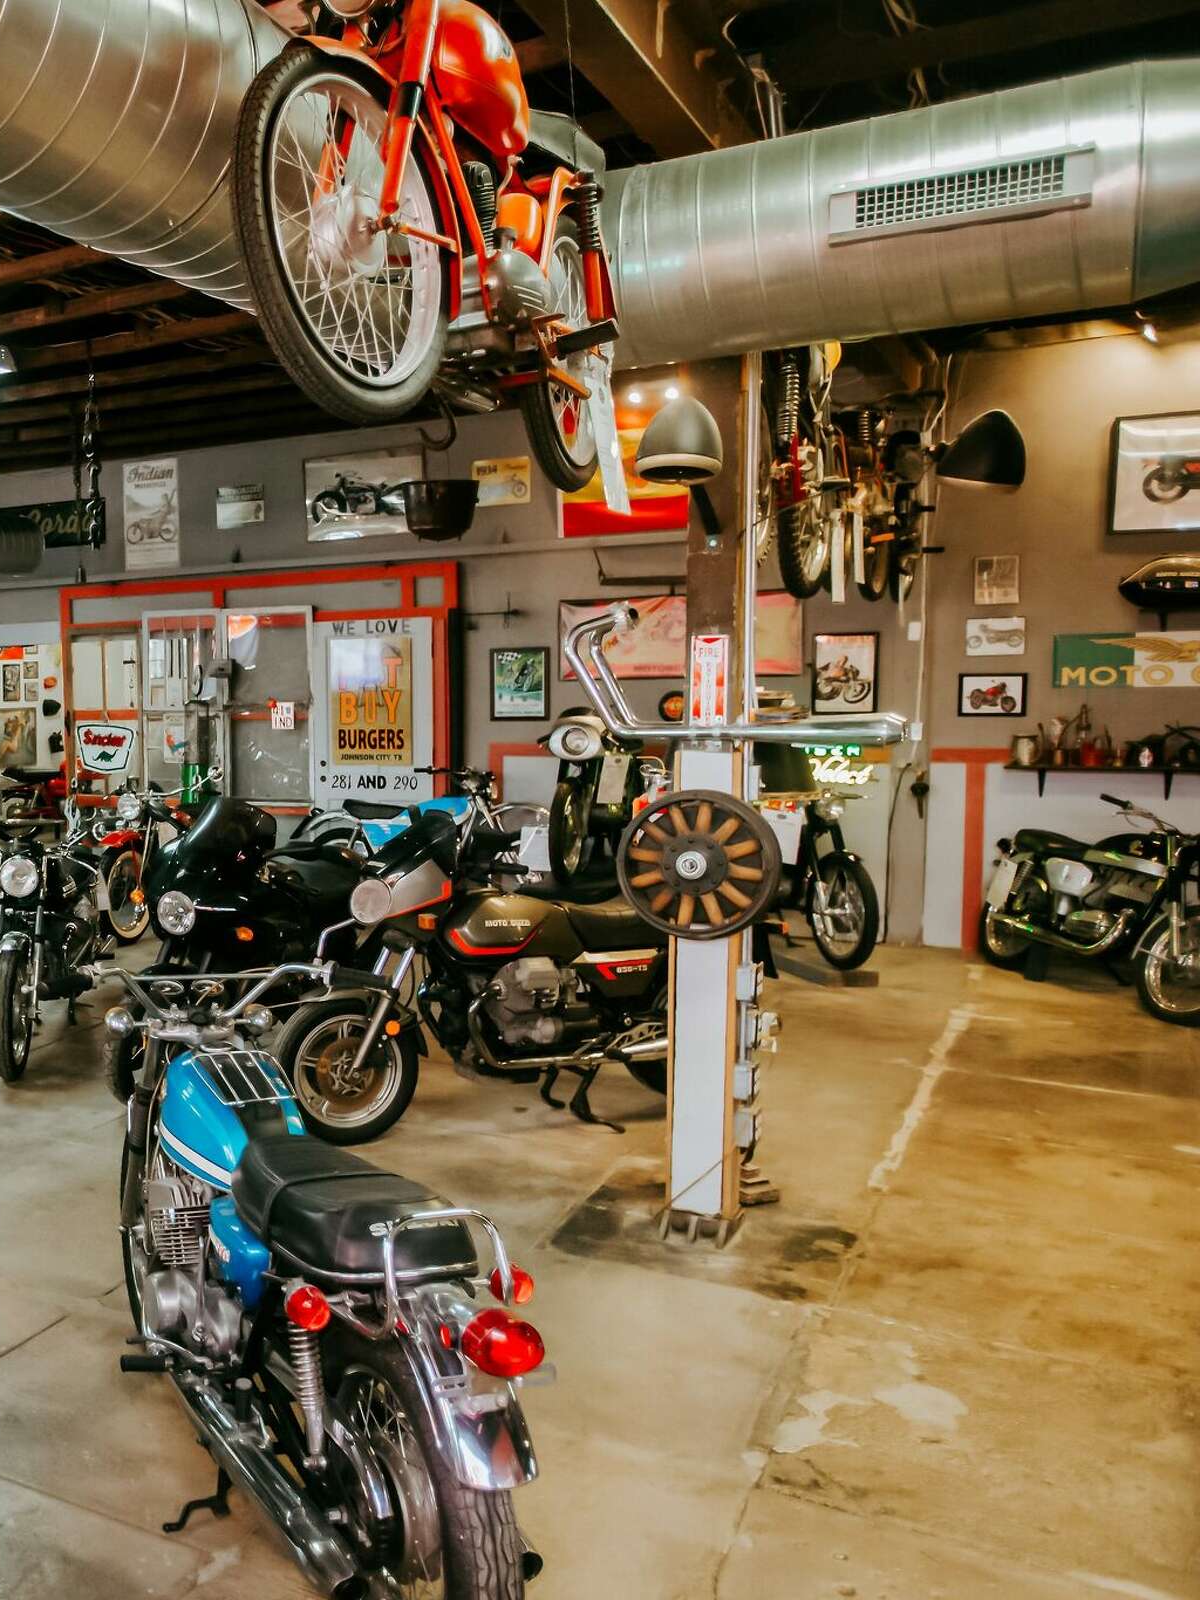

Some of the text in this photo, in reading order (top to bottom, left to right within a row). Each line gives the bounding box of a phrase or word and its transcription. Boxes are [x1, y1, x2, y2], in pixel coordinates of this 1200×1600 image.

[127, 466, 174, 483] Indian
[331, 619, 411, 636] WE LOVE
[699, 647, 721, 658] FIRE
[1060, 664, 1174, 687] MOTO
[338, 728, 405, 750] BURGERS
[340, 753, 375, 761] JOHNSON
[375, 753, 391, 761] CITY
[331, 775, 418, 791] 281 AND 290
